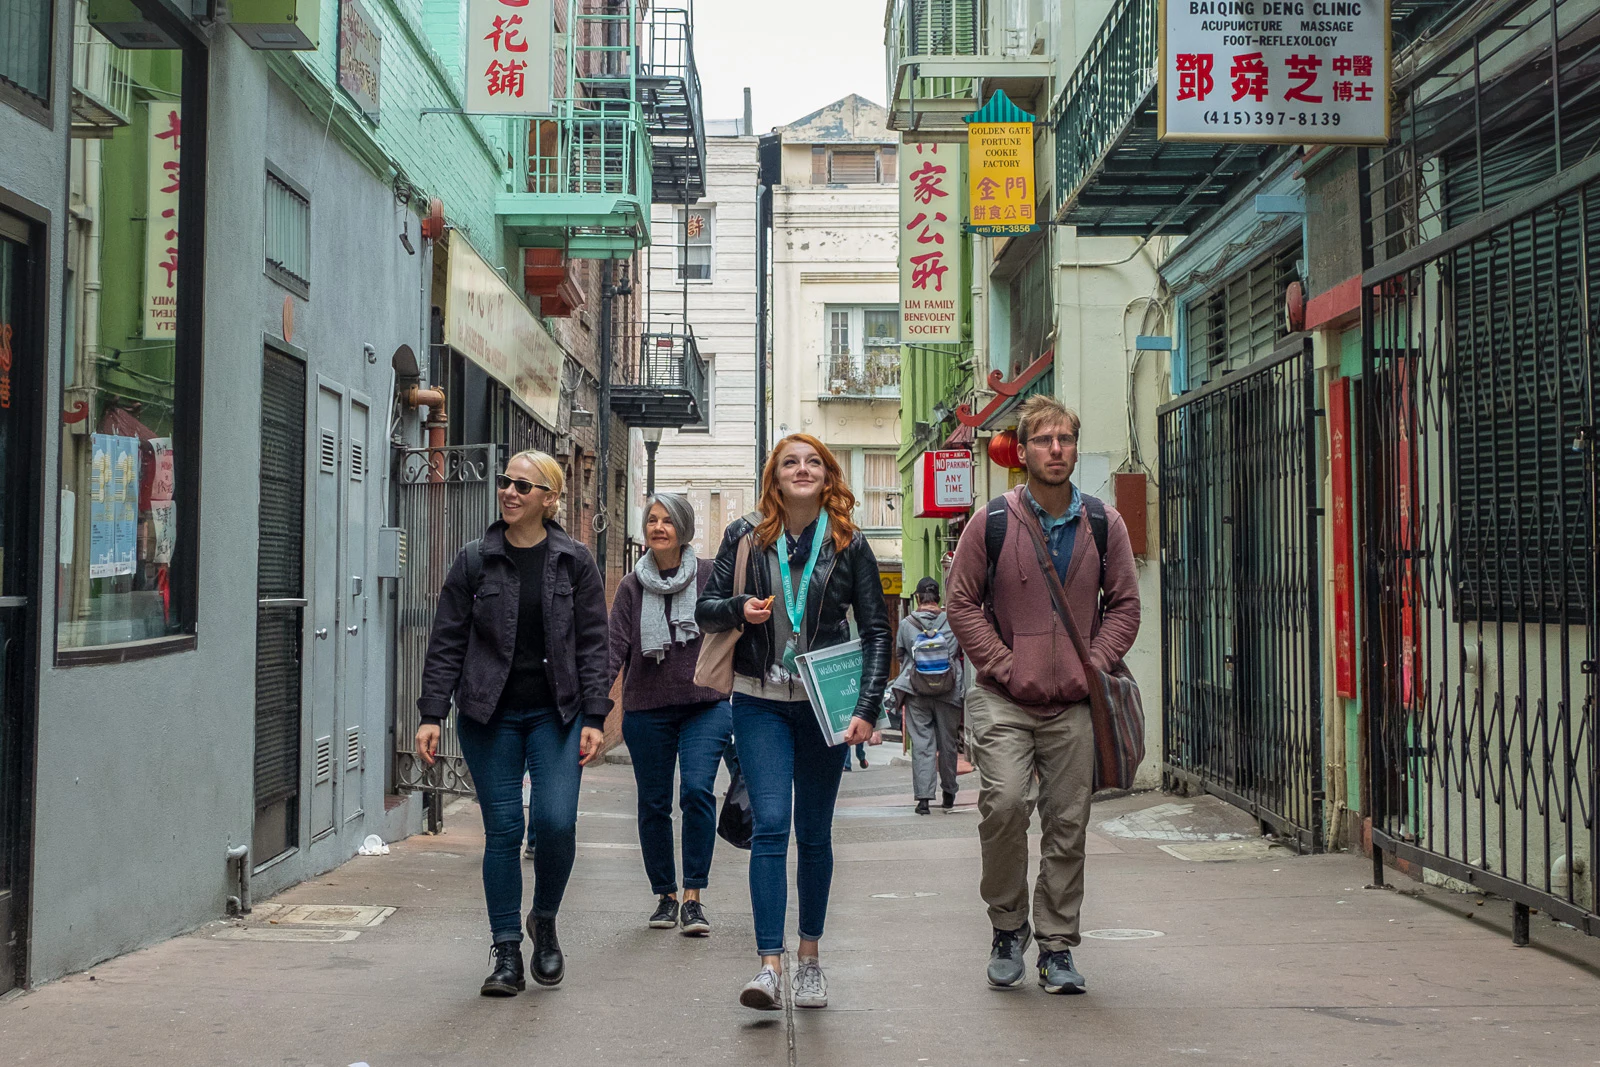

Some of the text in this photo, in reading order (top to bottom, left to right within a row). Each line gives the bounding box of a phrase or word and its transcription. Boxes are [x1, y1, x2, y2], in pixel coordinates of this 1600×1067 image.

[1189, 1, 1362, 17] BAIQING DENG CLINIC
[1201, 20, 1354, 32] ACUPUNCTURE MASSAGE
[1223, 35, 1338, 47] FOOT-REFLEXOLOGY
[483, 0, 529, 98] 花舖
[1176, 52, 1323, 103] 鄧舜芝
[1203, 111, 1341, 126] (415)397-8139
[971, 126, 1031, 135] GOLDEN GATE
[981, 138, 1022, 146] FORTUNE
[985, 149, 1018, 157] COOKIE
[983, 160, 1020, 168] FACTORY
[976, 176, 1027, 201] 金門
[904, 143, 949, 292] 家公所
[904, 300, 955, 309] LIM FAMILY
[904, 313, 955, 322] BENEVOLENT
[908, 325, 951, 335] SOCIETY
[936, 459, 970, 470] NO PARKING
[945, 474, 962, 482] ANY
[945, 484, 963, 493] TIME
[818, 665, 833, 676] Walk
[833, 664, 841, 673] On
[840, 659, 855, 671] Walk
